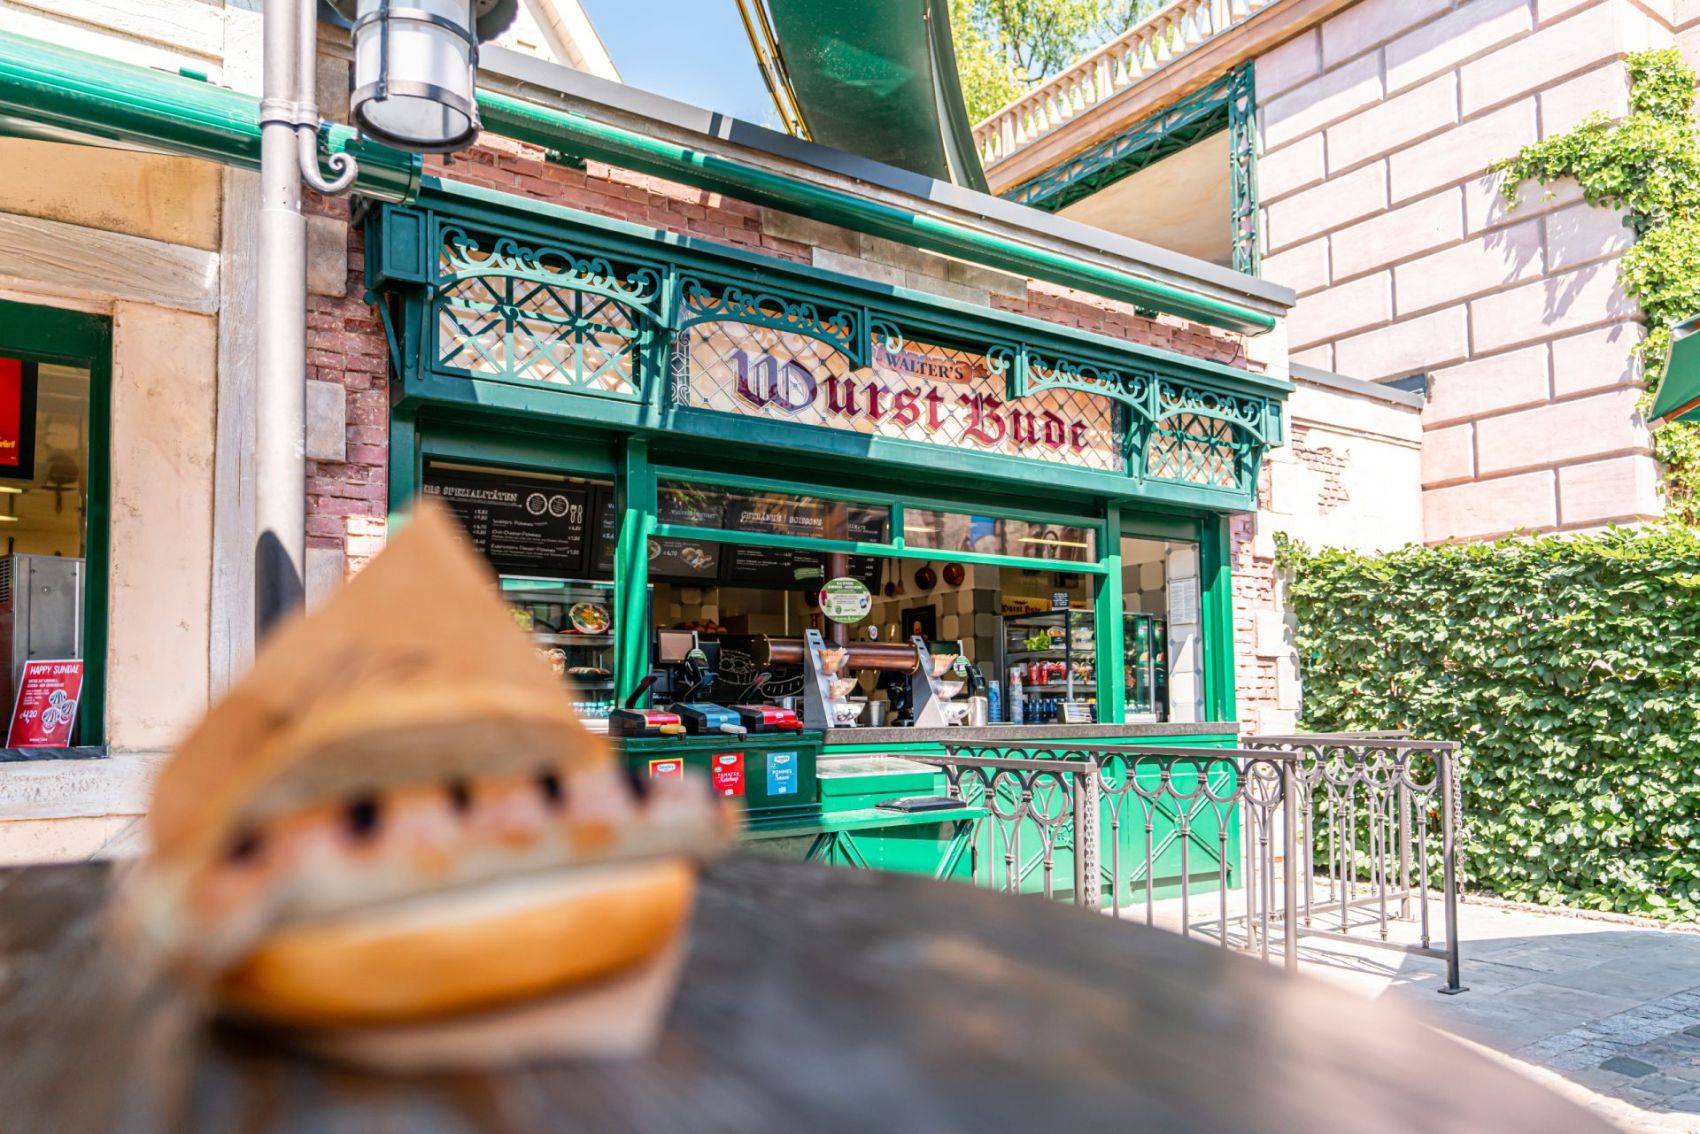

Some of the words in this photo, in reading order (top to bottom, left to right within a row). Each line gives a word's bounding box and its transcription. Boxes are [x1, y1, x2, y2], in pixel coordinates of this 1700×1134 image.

[885, 352, 965, 380] WALTER'S
[731, 349, 948, 433] Wurst
[957, 391, 1091, 455] Bude
[443, 486, 519, 502] SPEZIALITÄTEN
[30, 665, 53, 675] HAPPY
[53, 665, 79, 674] SUNDAE
